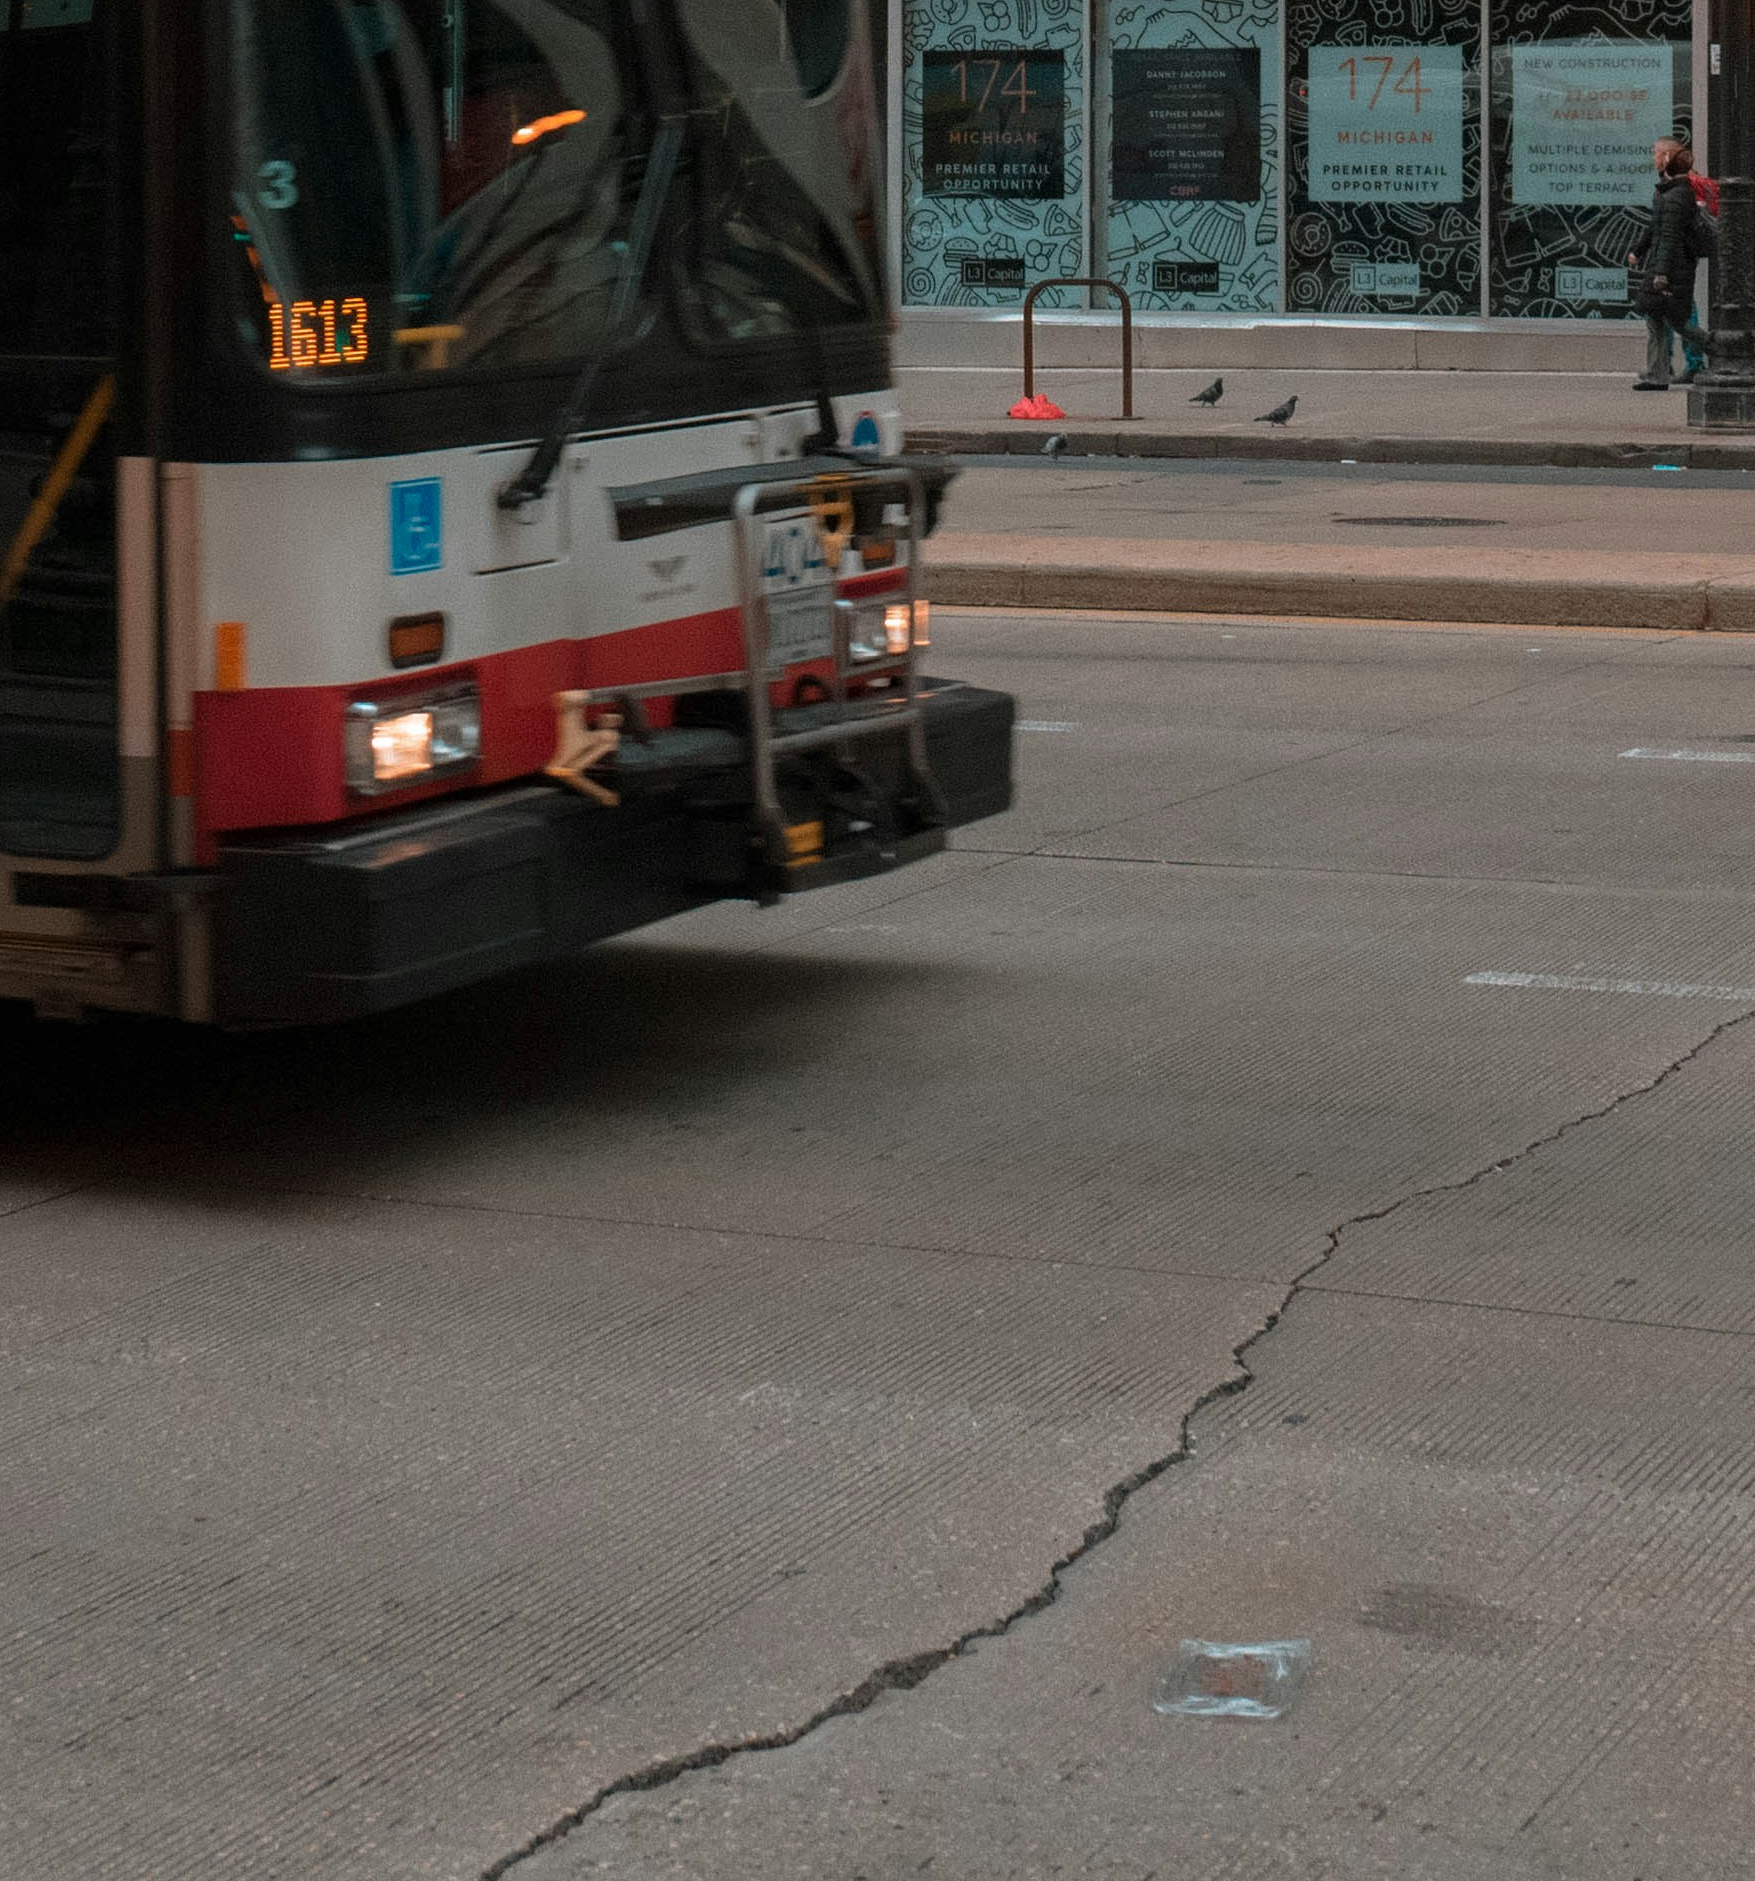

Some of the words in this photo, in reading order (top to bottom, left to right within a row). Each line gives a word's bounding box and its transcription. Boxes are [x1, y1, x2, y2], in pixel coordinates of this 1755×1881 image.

[1524, 58, 1553, 69] NEW
[1558, 57, 1662, 69] CONSTRUCTION
[949, 59, 1037, 113] 174
[1338, 55, 1432, 113] 174
[948, 131, 1038, 145] MICHIGAN
[1337, 131, 1433, 144] MICHIGAN
[1528, 144, 1590, 156] MULTIPLE
[935, 163, 996, 176] PREMIER
[1003, 163, 1051, 176] RETAIL
[1323, 164, 1388, 176] PREMIER
[1396, 164, 1447, 176] RETAIL
[1529, 163, 1586, 175] OPTIONS
[257, 160, 299, 210] 3
[943, 178, 1044, 191] OPPORTUNITY
[1331, 181, 1439, 192] OPPORTUNITY
[1548, 182, 1574, 193] TOP
[1579, 182, 1635, 193] TERRACE
[987, 266, 1023, 284] Capital
[1179, 269, 1217, 288] Capital
[1379, 271, 1417, 290] Capital
[1585, 275, 1625, 294] Capital
[268, 296, 369, 370] 1613
